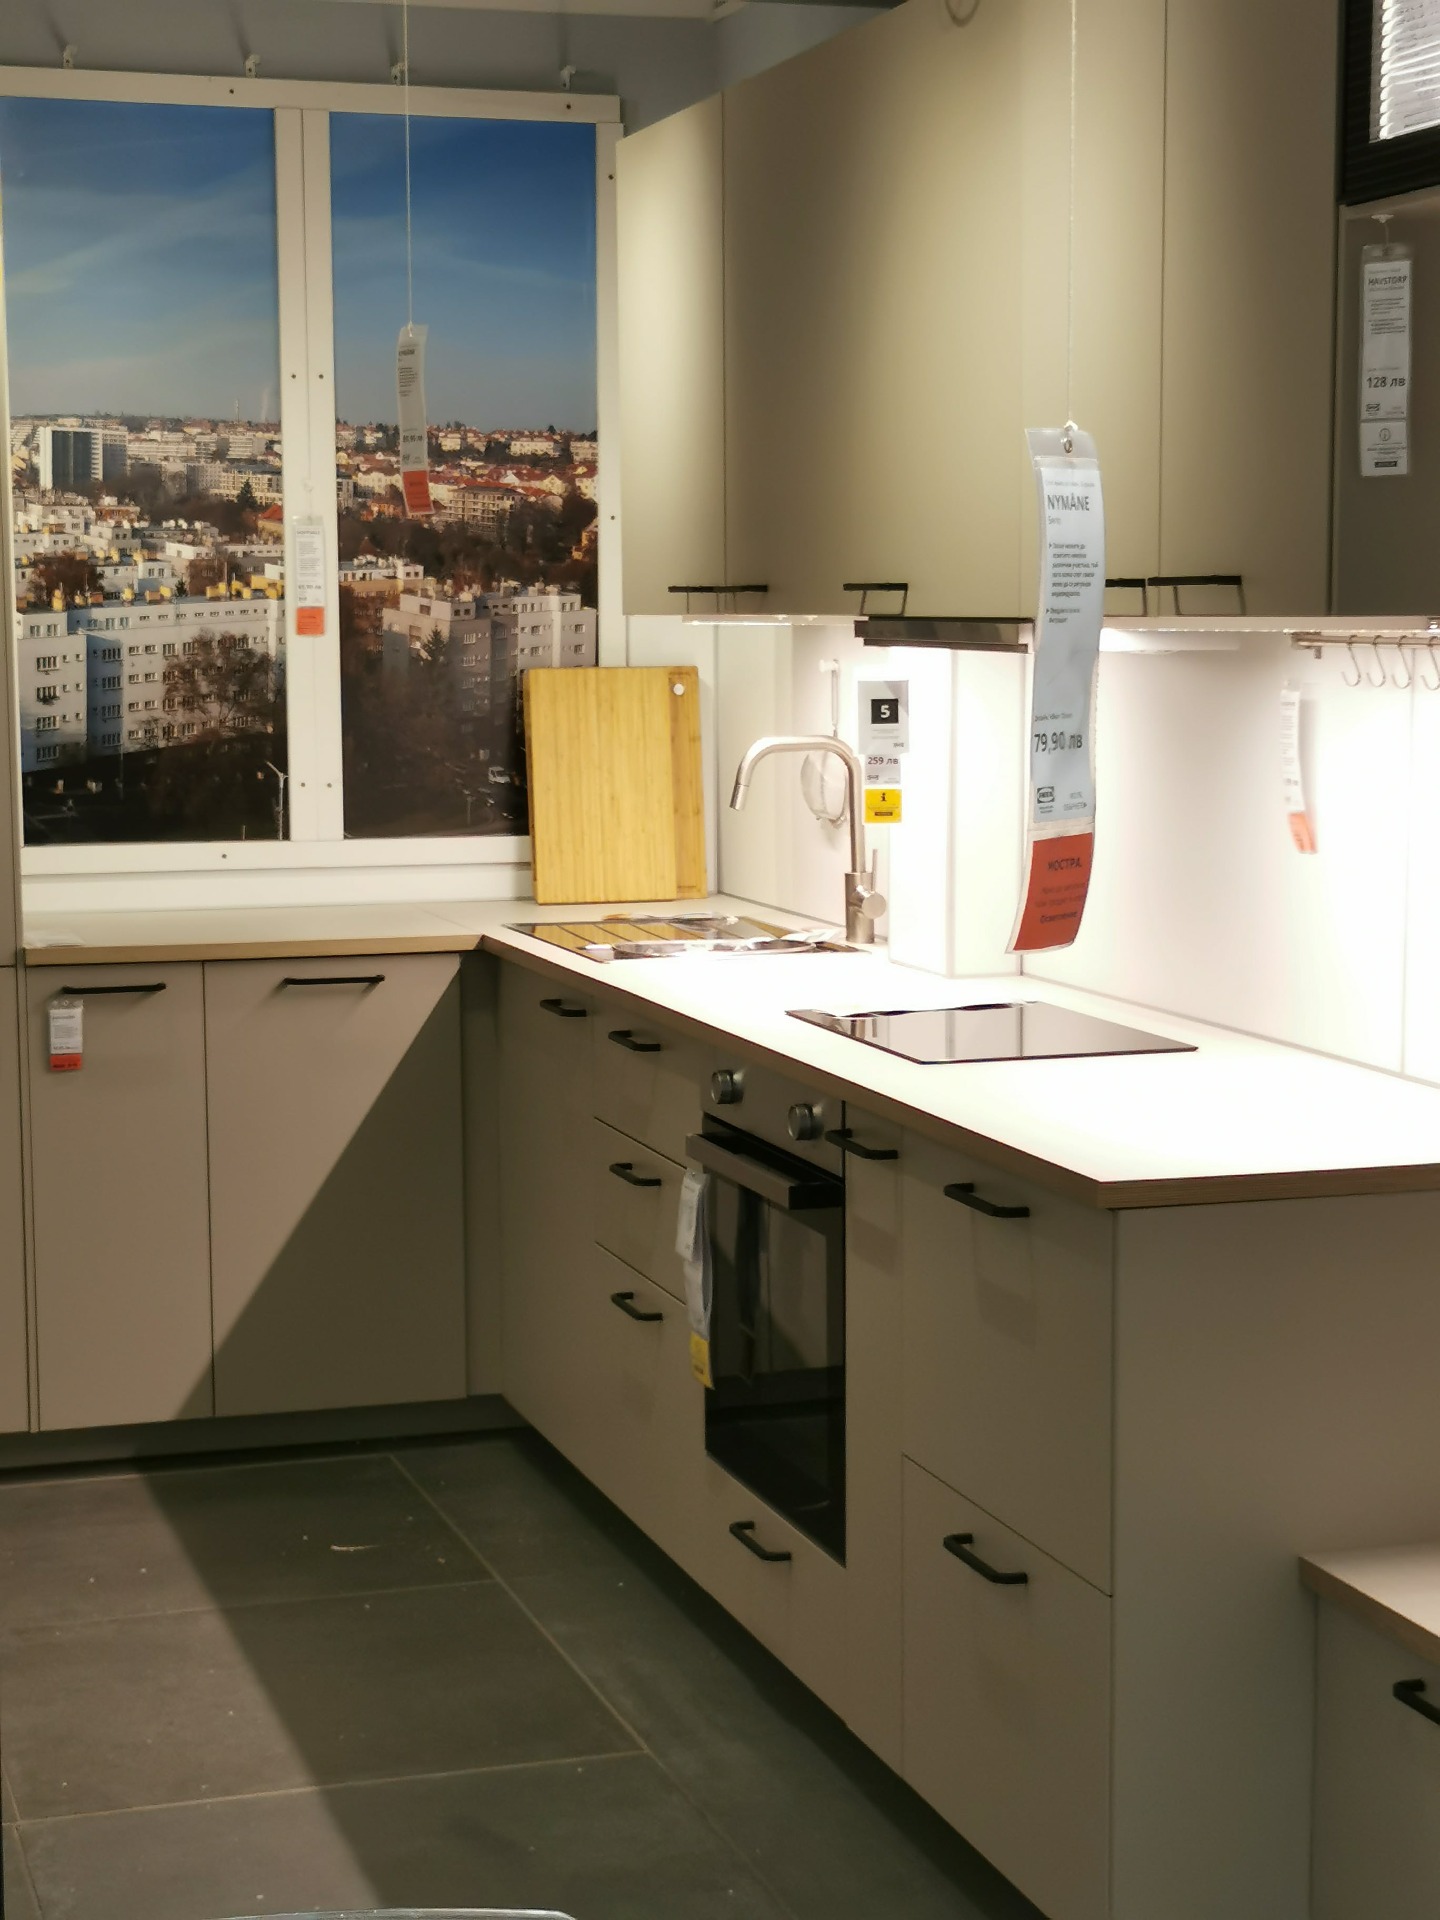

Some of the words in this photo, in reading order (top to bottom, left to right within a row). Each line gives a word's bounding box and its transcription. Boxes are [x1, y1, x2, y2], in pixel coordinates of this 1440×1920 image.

[1366, 376, 1387, 389] 128
[1389, 378, 1407, 388] лв
[1047, 492, 1090, 511] NYMÅNE
[880, 704, 891, 718] 5
[1033, 732, 1066, 755] 79,90
[867, 756, 884, 765] 259
